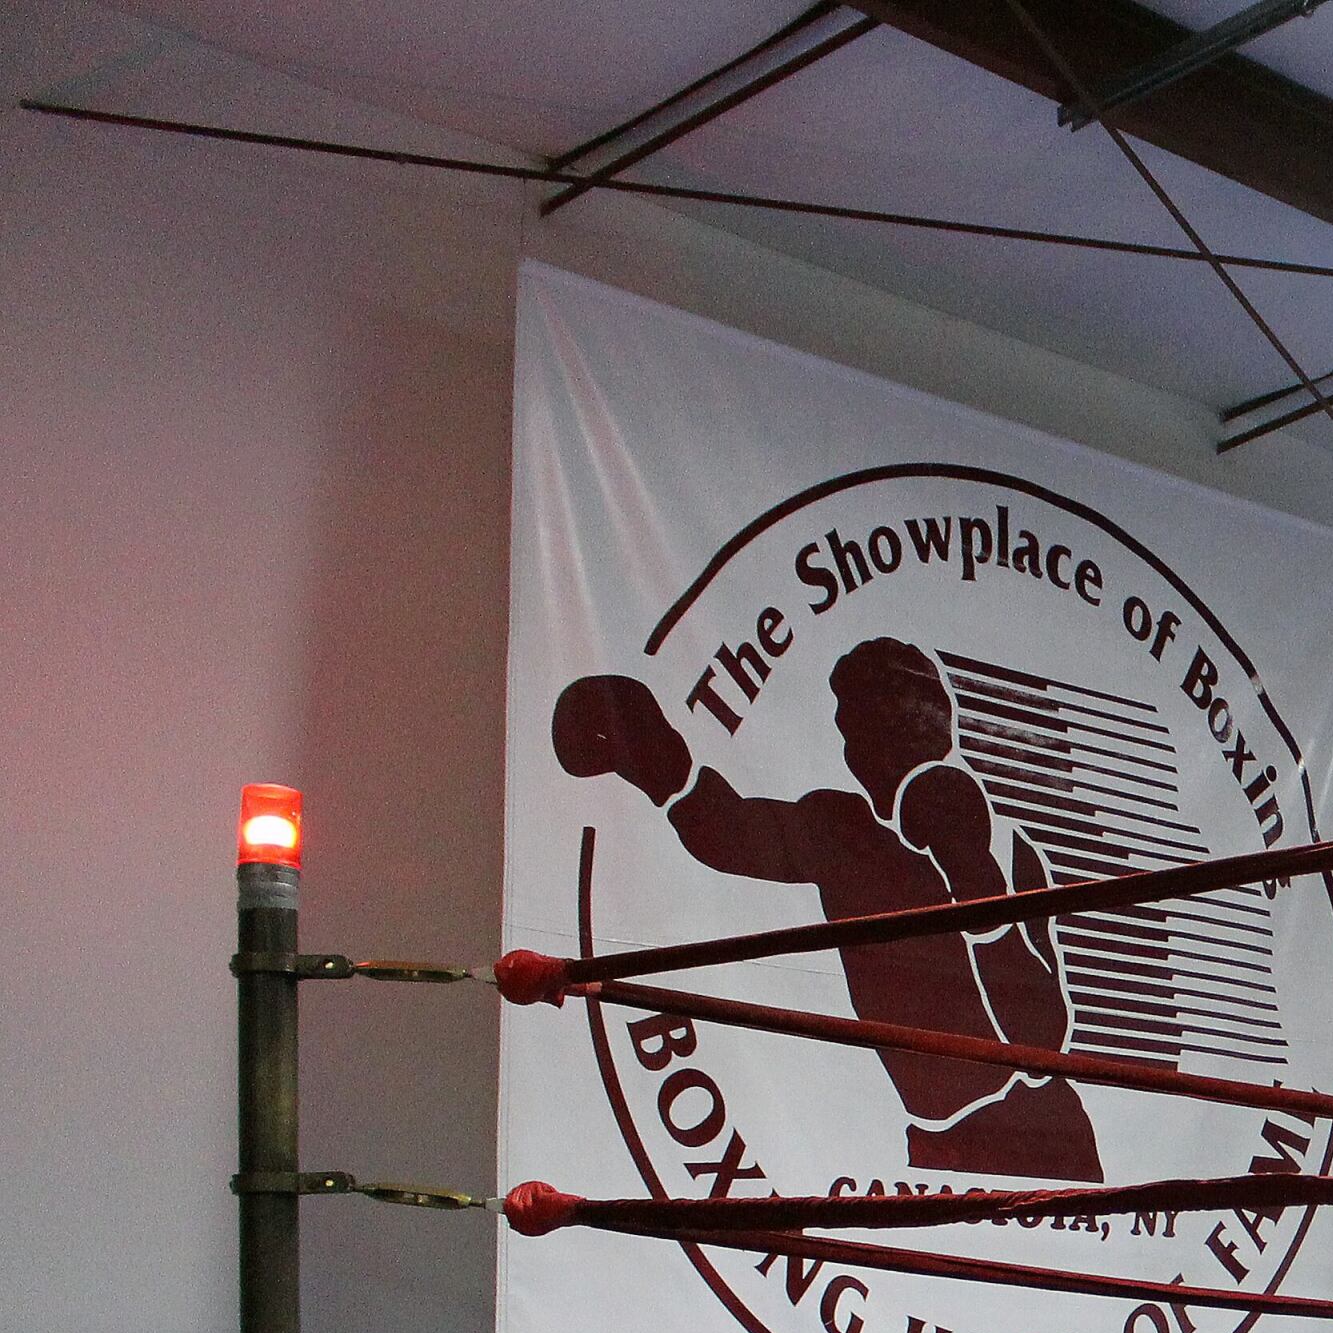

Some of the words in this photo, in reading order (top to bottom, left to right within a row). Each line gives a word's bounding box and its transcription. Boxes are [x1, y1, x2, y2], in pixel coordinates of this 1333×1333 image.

[686, 605, 793, 736] The
[795, 505, 1104, 615] Showplace
[1123, 597, 1183, 663] of
[1204, 1079, 1320, 1284] FAM
